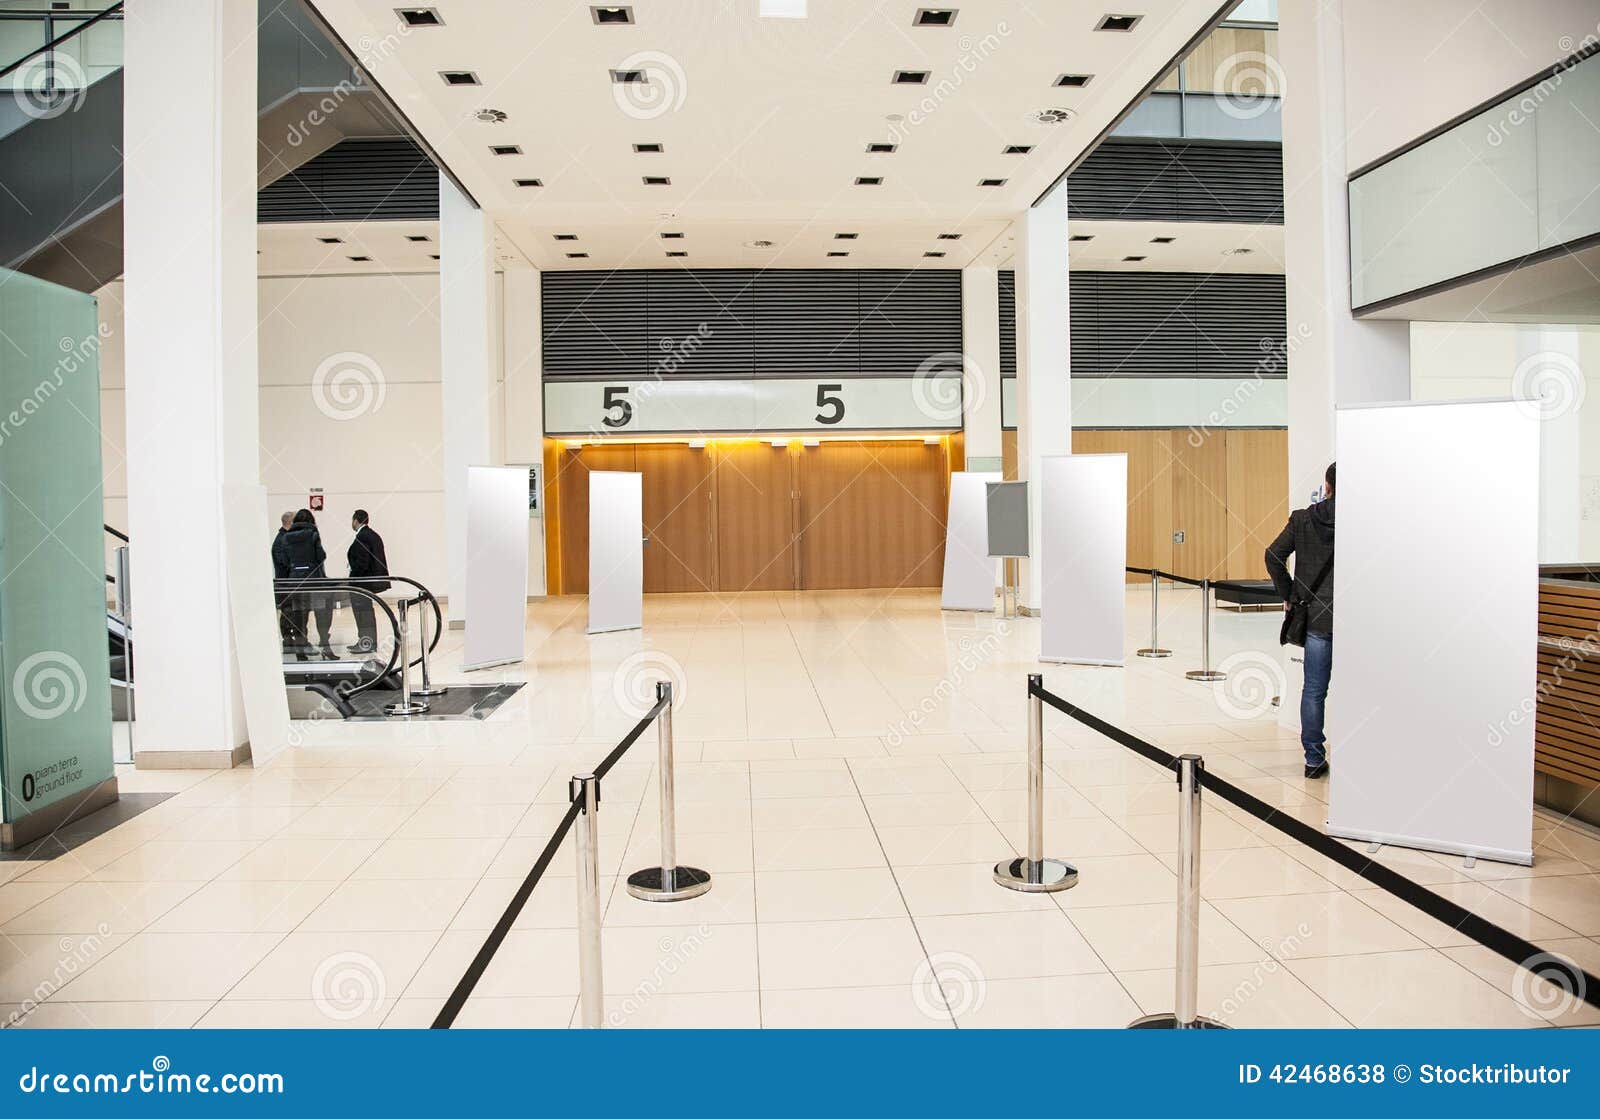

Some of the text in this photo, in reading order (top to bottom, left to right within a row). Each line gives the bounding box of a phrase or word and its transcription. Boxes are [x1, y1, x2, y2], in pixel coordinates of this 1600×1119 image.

[601, 386, 632, 427] 5
[814, 384, 846, 425] 5
[35, 756, 78, 783] piano terra
[35, 769, 83, 799] ground floor
[22, 773, 35, 802] 0
